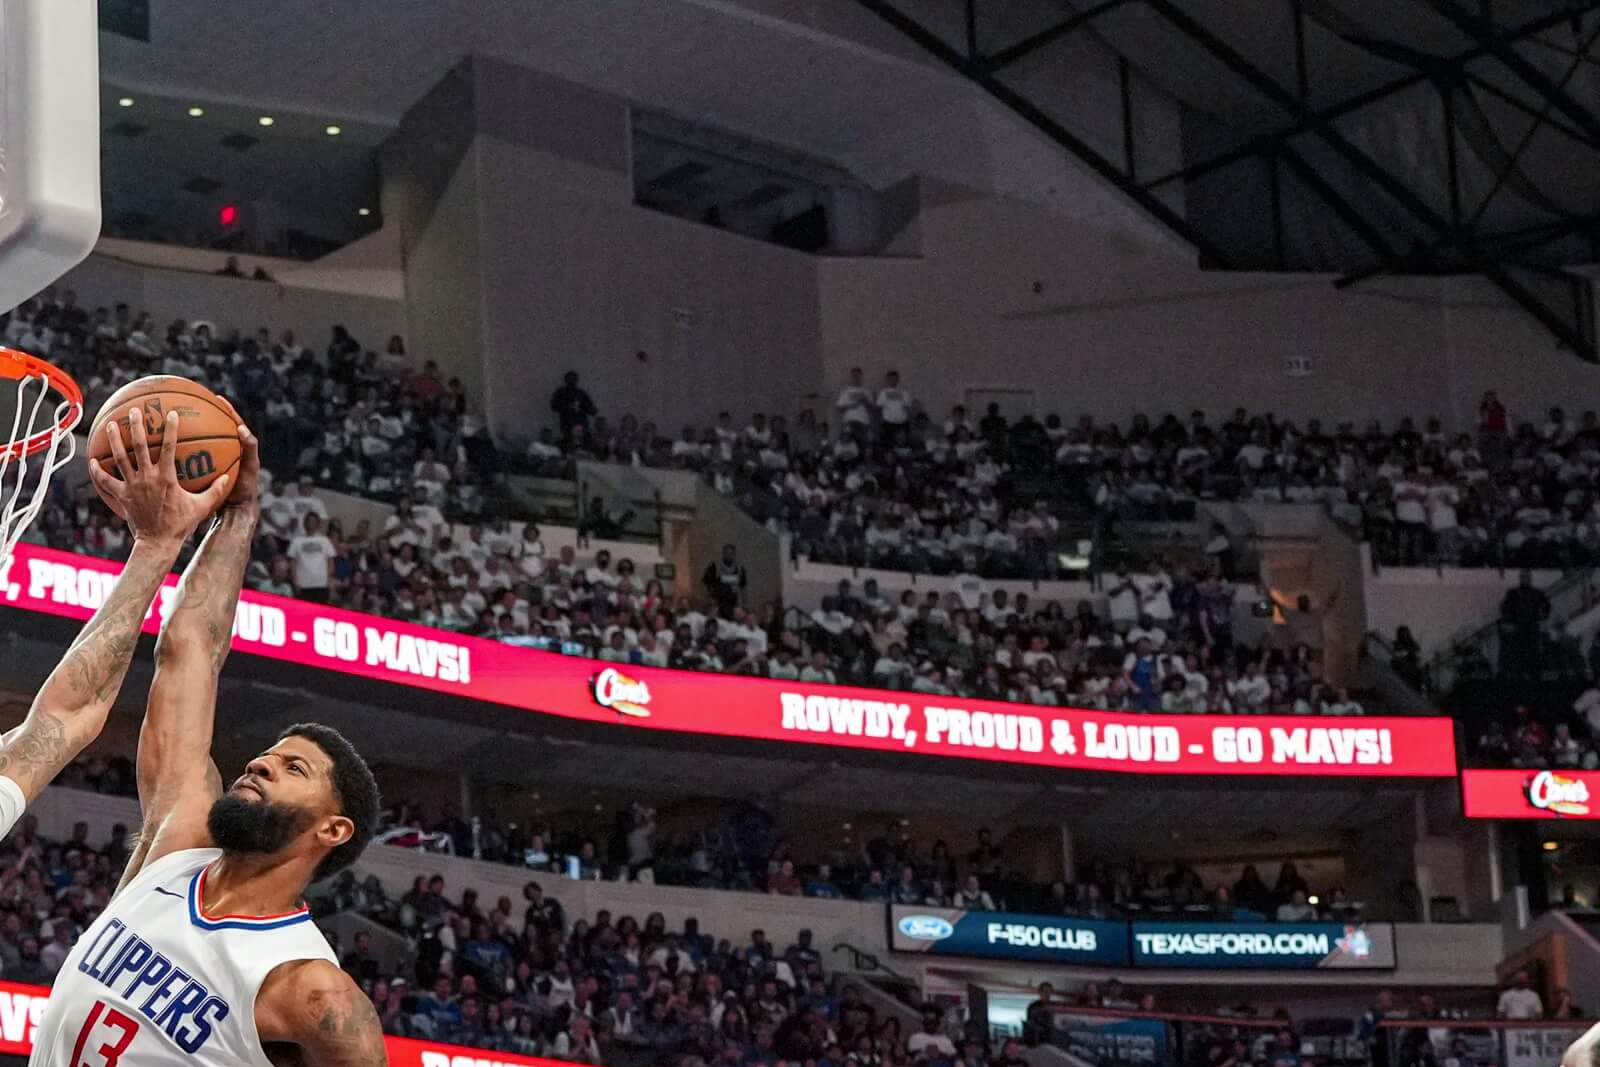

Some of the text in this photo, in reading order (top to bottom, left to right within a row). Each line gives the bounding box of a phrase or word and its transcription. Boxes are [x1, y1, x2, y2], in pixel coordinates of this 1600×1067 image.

[29, 559, 140, 620] PROU
[232, 600, 286, 646] OUD
[314, 618, 359, 660] GO
[365, 628, 471, 683] MAVS!
[781, 693, 918, 747] ROWDY,
[924, 707, 1044, 753] PROUD
[1051, 720, 1077, 754] &
[1083, 722, 1181, 761] LOUD
[1212, 727, 1264, 763] GO
[1270, 728, 1392, 764] MAVS!
[988, 923, 1041, 947] F-150
[1041, 928, 1097, 950] CLUB
[1136, 933, 1328, 956] TEXASFORD.COM
[78, 917, 229, 1054] CLIPPERS
